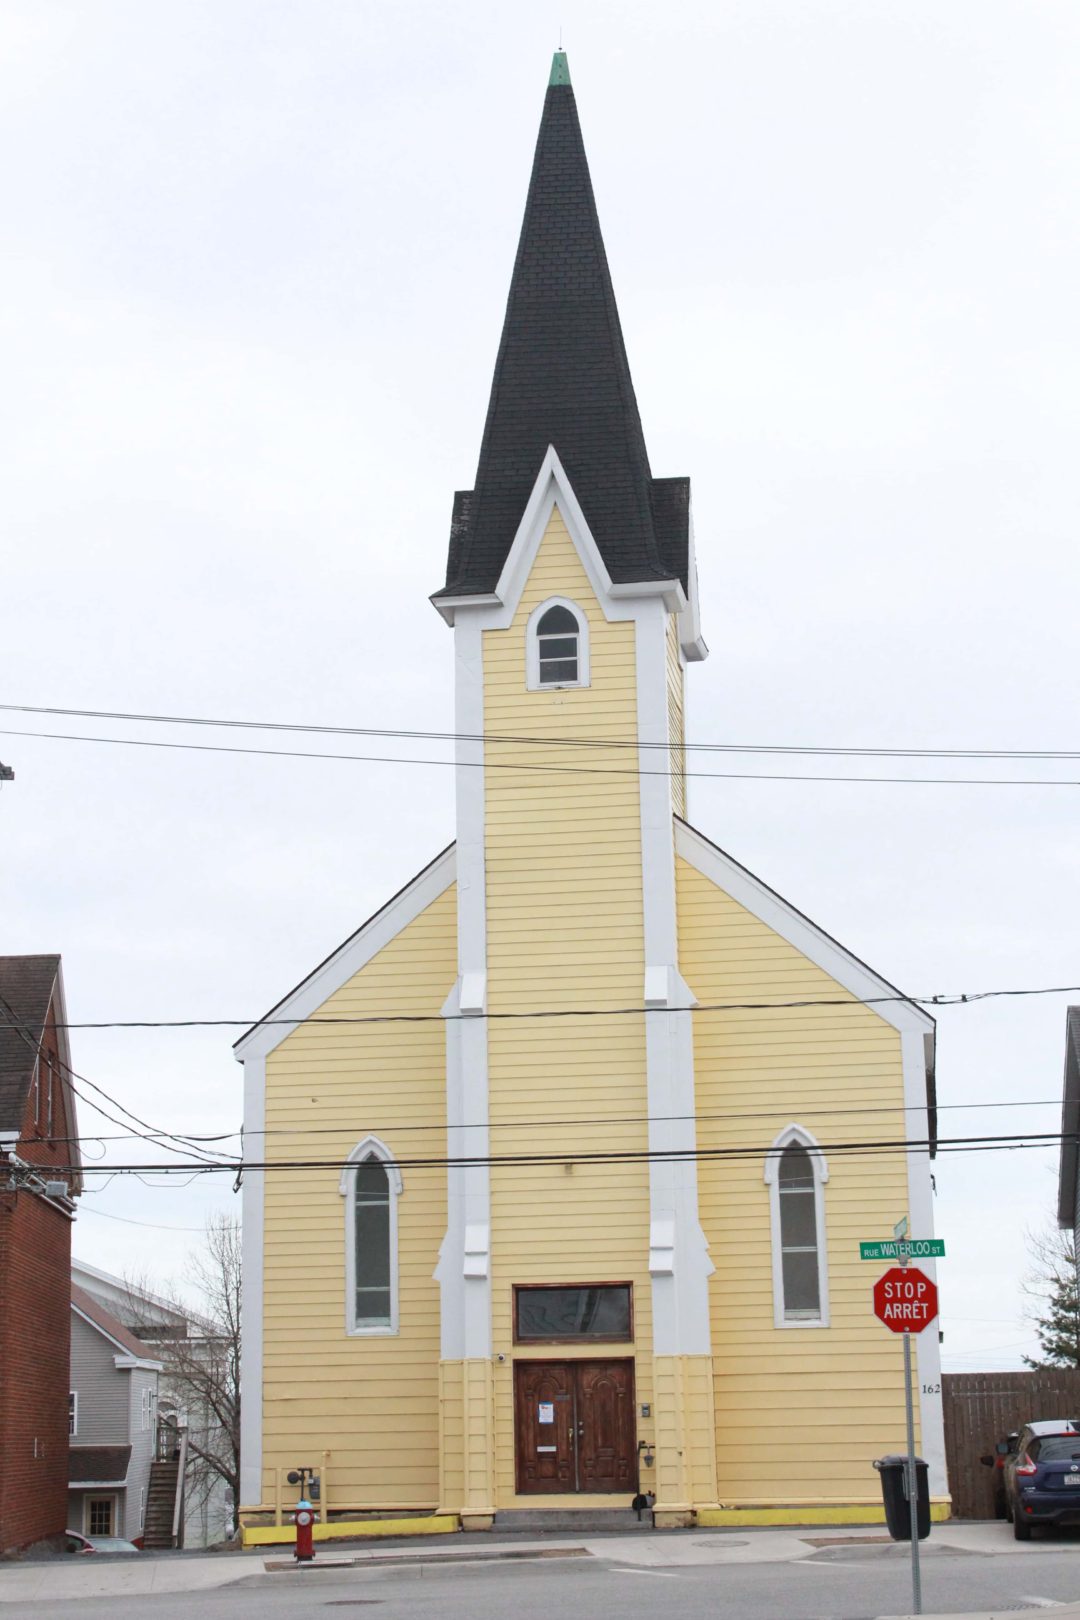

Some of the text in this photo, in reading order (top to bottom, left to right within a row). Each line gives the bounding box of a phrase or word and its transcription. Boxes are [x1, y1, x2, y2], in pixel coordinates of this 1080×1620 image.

[864, 1242, 941, 1257] RUE WATERLOO ST
[884, 1282, 927, 1298] STOP
[884, 1300, 928, 1318] ARRÊT
[922, 1384, 941, 1394] 162
